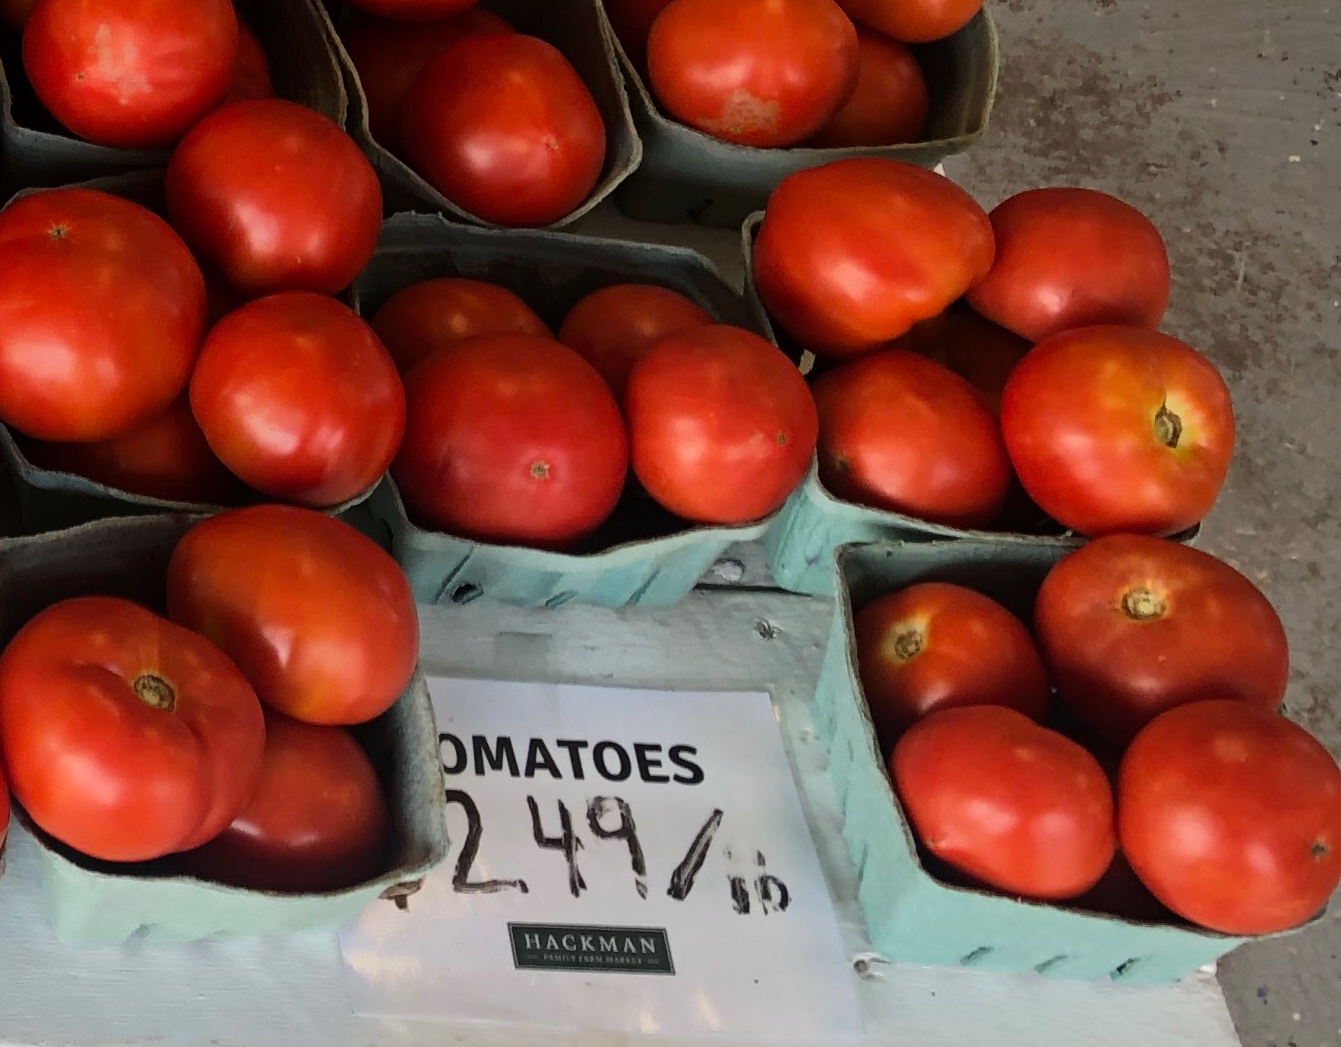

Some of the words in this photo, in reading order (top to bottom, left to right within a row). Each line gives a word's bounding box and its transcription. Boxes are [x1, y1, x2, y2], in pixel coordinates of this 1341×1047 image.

[439, 733, 705, 785] OMATOES
[523, 932, 657, 954] HACKMAN
[543, 953, 576, 963] FAMILY
